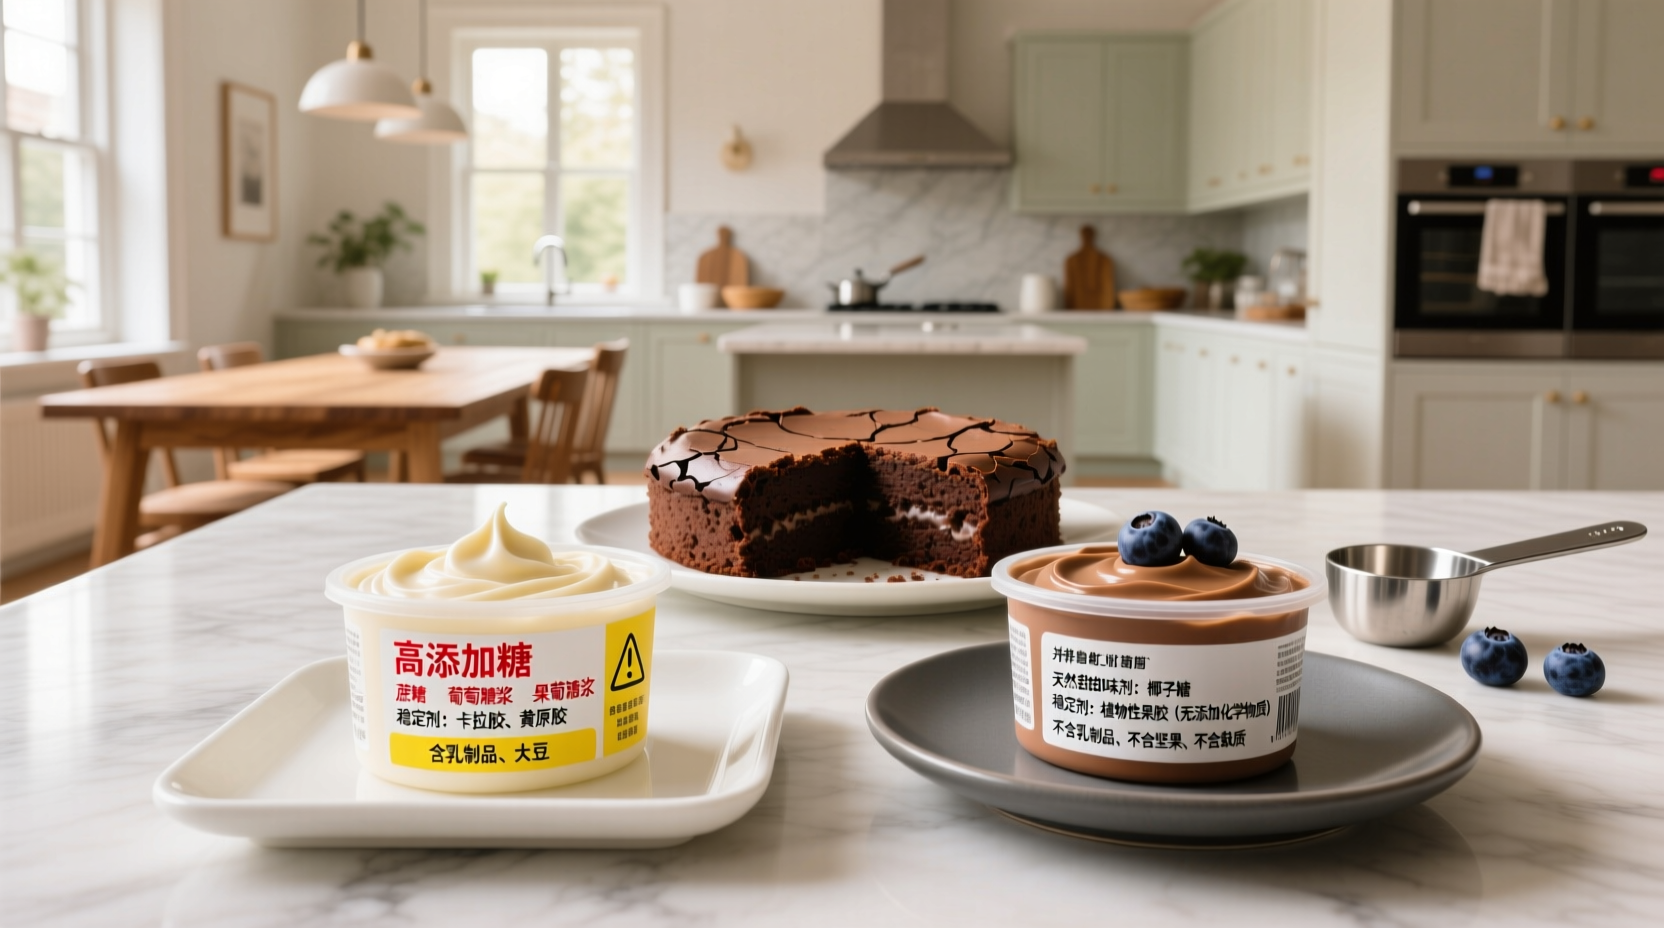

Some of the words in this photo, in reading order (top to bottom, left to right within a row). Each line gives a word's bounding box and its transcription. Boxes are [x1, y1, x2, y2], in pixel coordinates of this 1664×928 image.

[394, 640, 533, 679] 高添加糖
[396, 683, 427, 704] 蔗糖
[429, 742, 550, 765] 含乳制品、大豆
